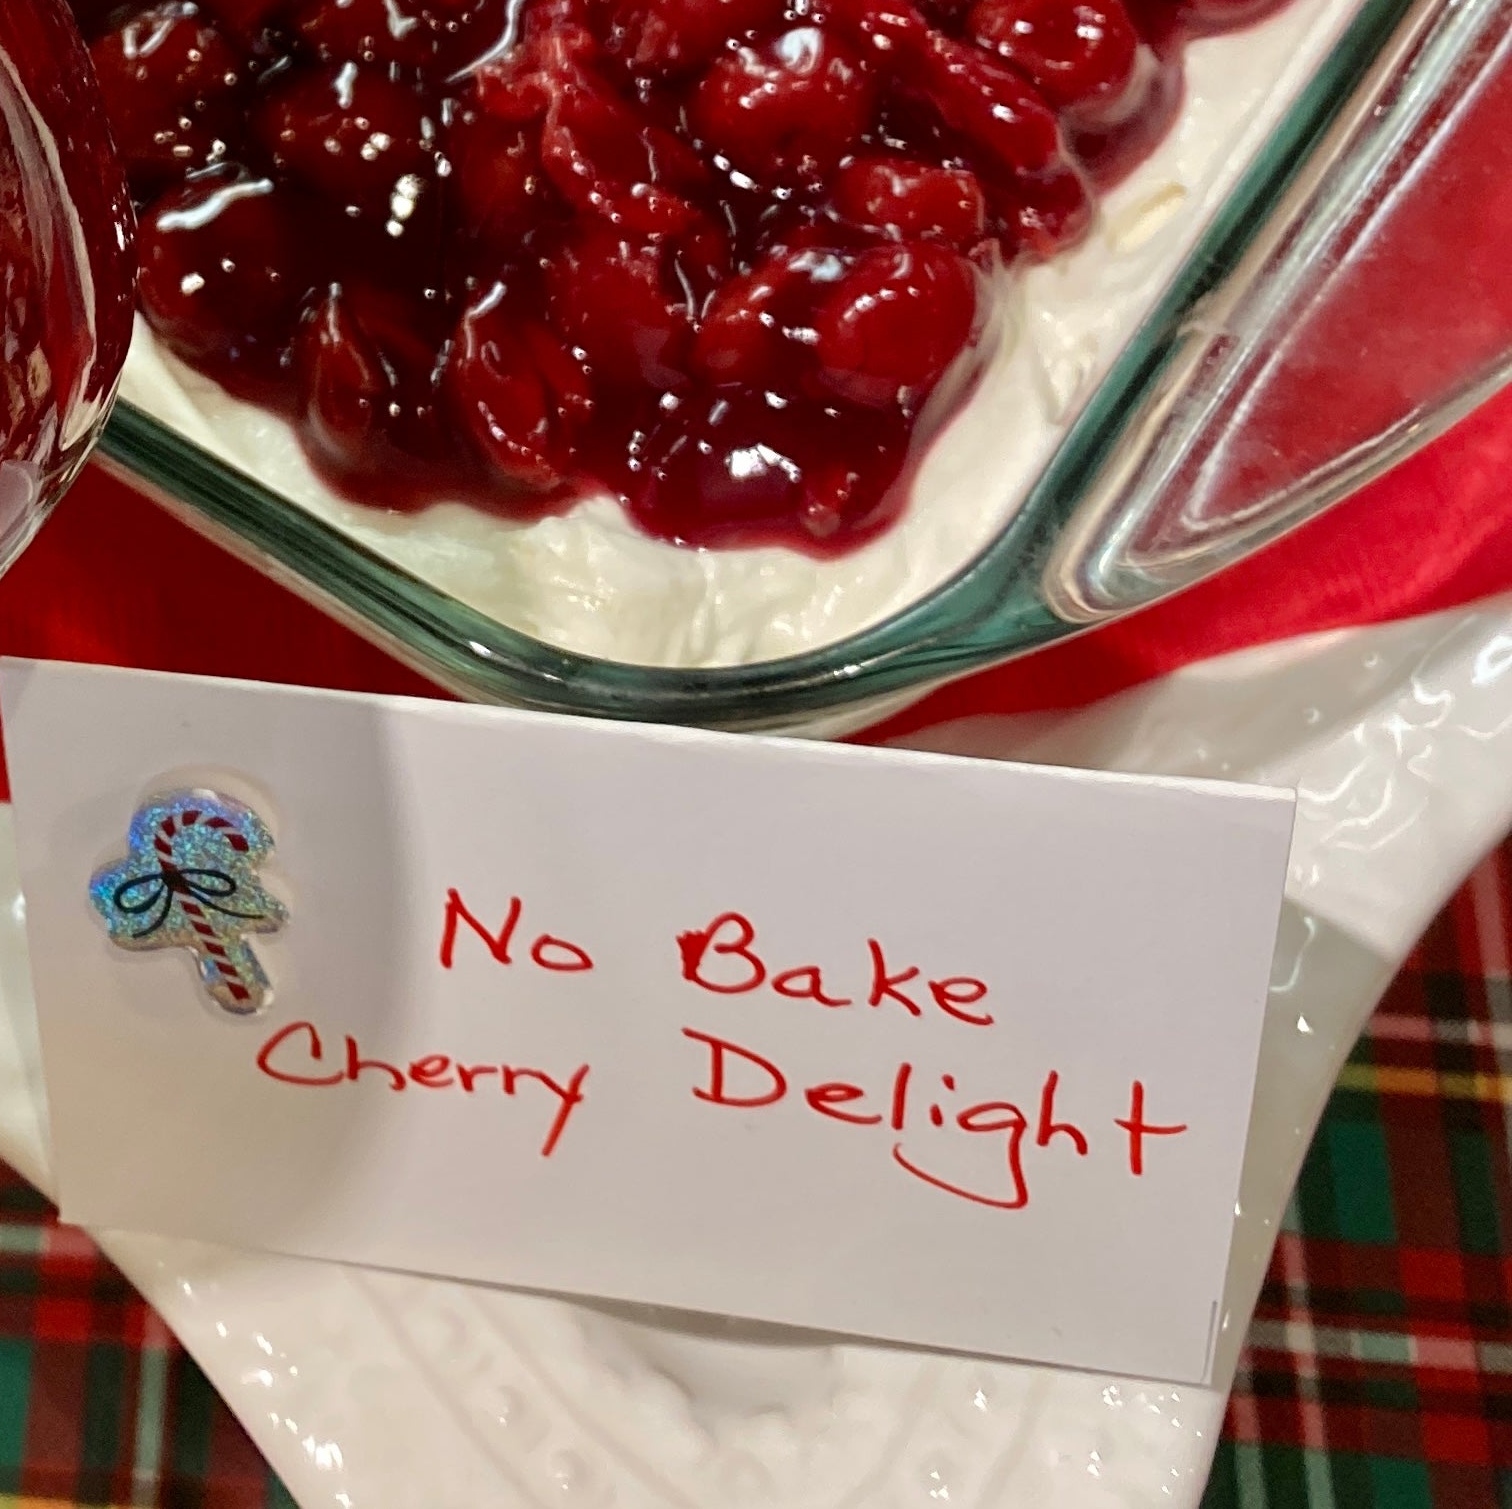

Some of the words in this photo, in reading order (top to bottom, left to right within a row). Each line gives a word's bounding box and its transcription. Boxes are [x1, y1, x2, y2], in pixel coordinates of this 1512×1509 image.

[438, 887, 595, 974] No
[675, 911, 994, 1027] Bake
[255, 1021, 590, 1158] Cherry
[682, 1027, 1188, 1211] Delight
